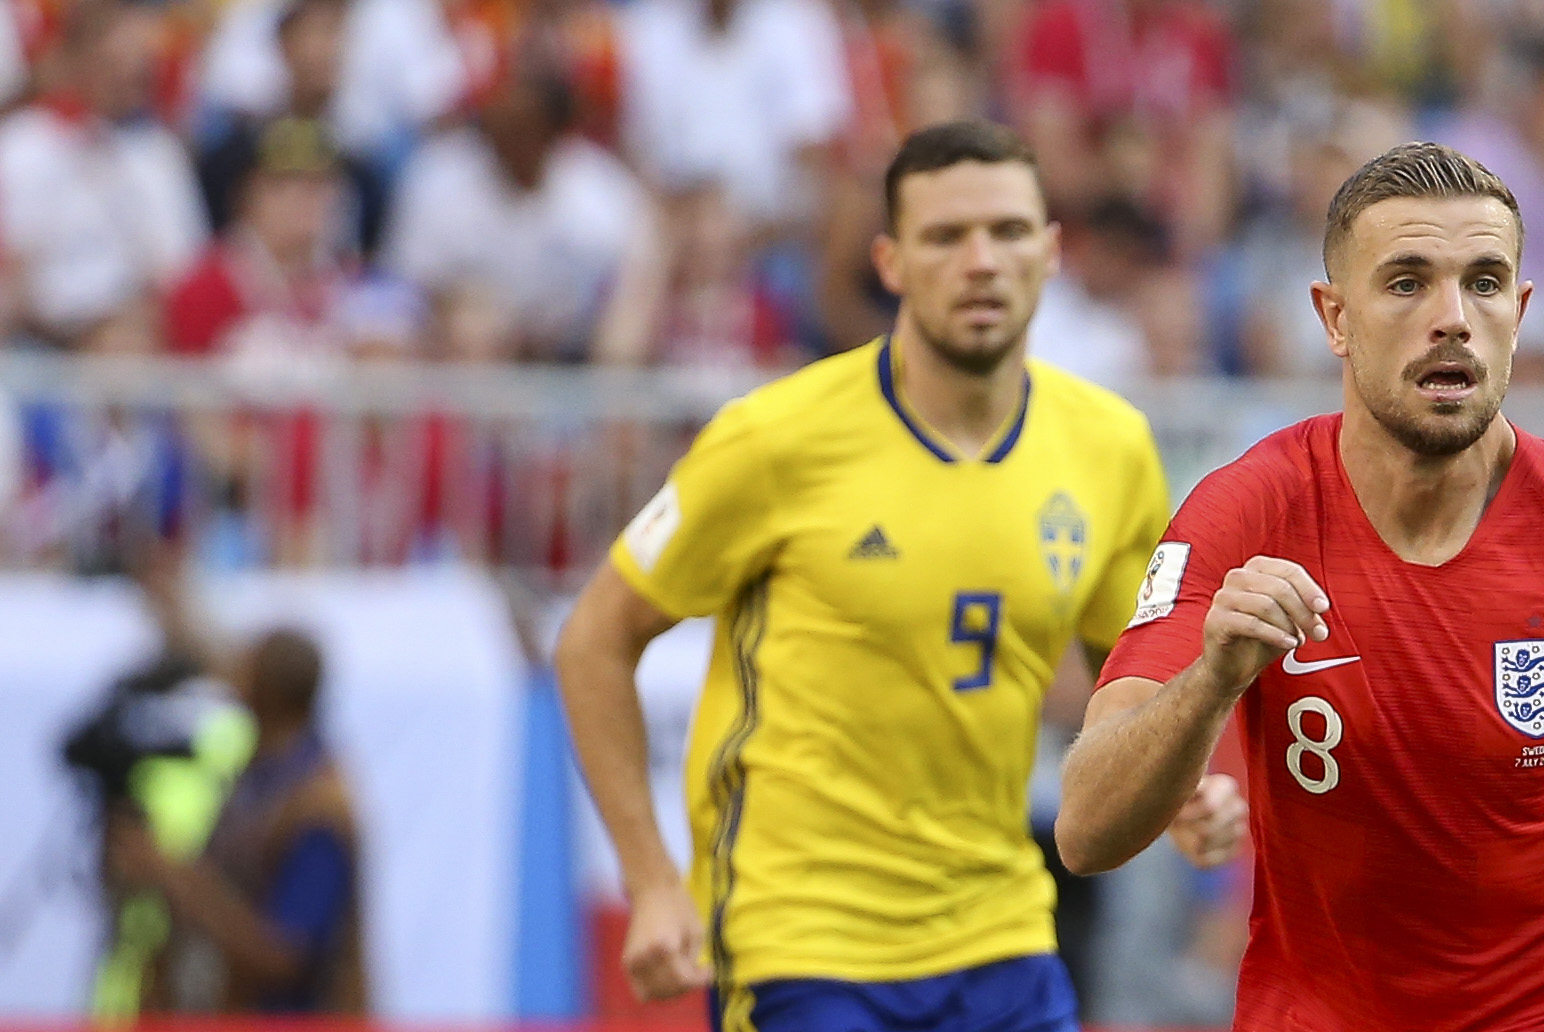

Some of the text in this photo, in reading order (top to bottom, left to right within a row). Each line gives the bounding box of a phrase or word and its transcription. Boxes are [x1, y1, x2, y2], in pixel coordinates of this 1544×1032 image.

[950, 590, 1002, 693] 9
[1286, 695, 1344, 795] 8
[1514, 758, 1521, 768] 7
[1521, 758, 1539, 768] JULY
